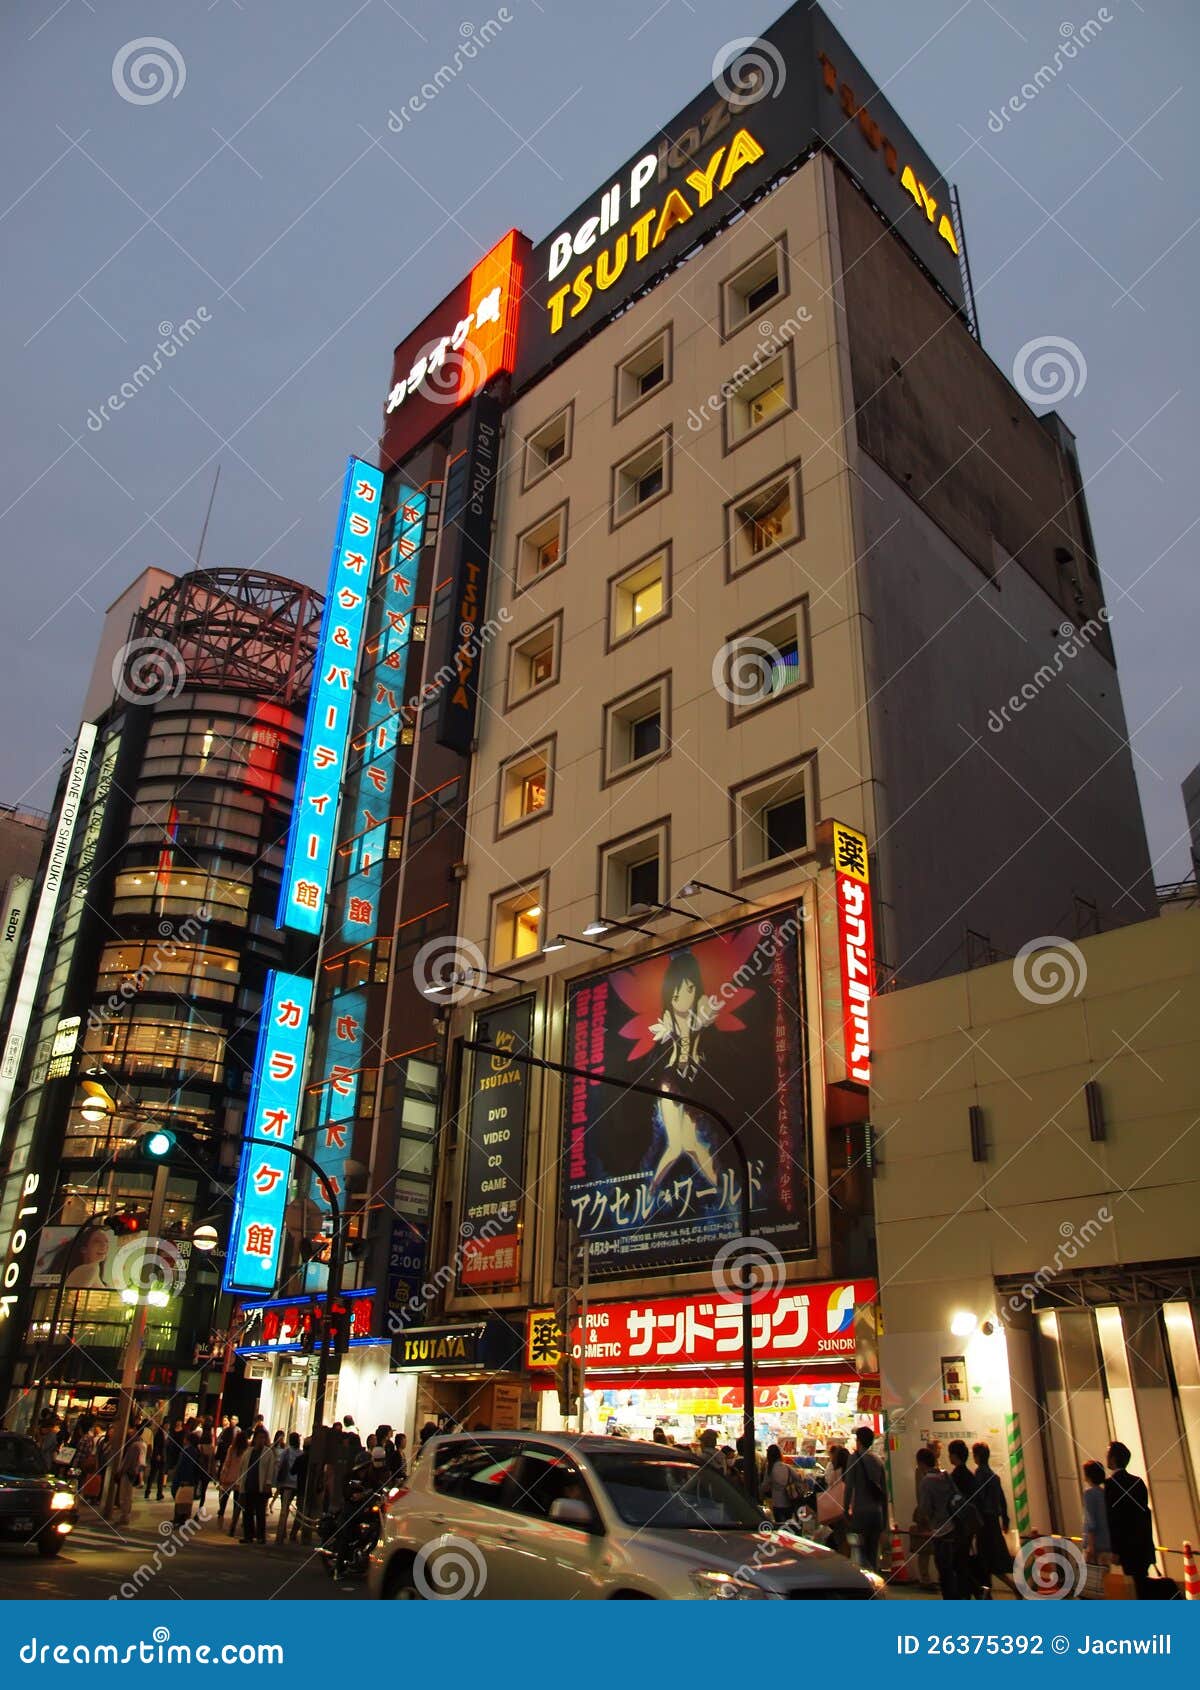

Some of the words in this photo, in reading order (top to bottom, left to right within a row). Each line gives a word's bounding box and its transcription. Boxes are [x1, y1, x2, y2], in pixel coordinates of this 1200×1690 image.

[546, 128, 765, 335] TSUTAYA
[548, 183, 620, 282] Bell
[478, 422, 495, 460] Bell
[472, 463, 491, 516] Plaza
[453, 561, 480, 710] TSUTAYA
[68, 748, 89, 799] MEGANE
[63, 801, 77, 826] TOP
[47, 828, 71, 892] SHINJUKU
[837, 830, 865, 877] 薬
[590, 982, 609, 1064] Welcome
[480, 1069, 521, 1092] TSUTAYA
[572, 1019, 589, 1124] accelrated
[245, 1001, 302, 1257] カラオケ館
[483, 1130, 511, 1145] VIDEO
[488, 1107, 508, 1122] DVD
[488, 1154, 502, 1168] CD
[570, 1126, 587, 1180] world
[481, 1177, 507, 1192] GAME
[404, 1338, 466, 1361] TSUTAYA
[590, 1329, 598, 1343] &
[626, 1294, 811, 1358] サンドラッグ
[818, 1338, 856, 1351] SUNDR
